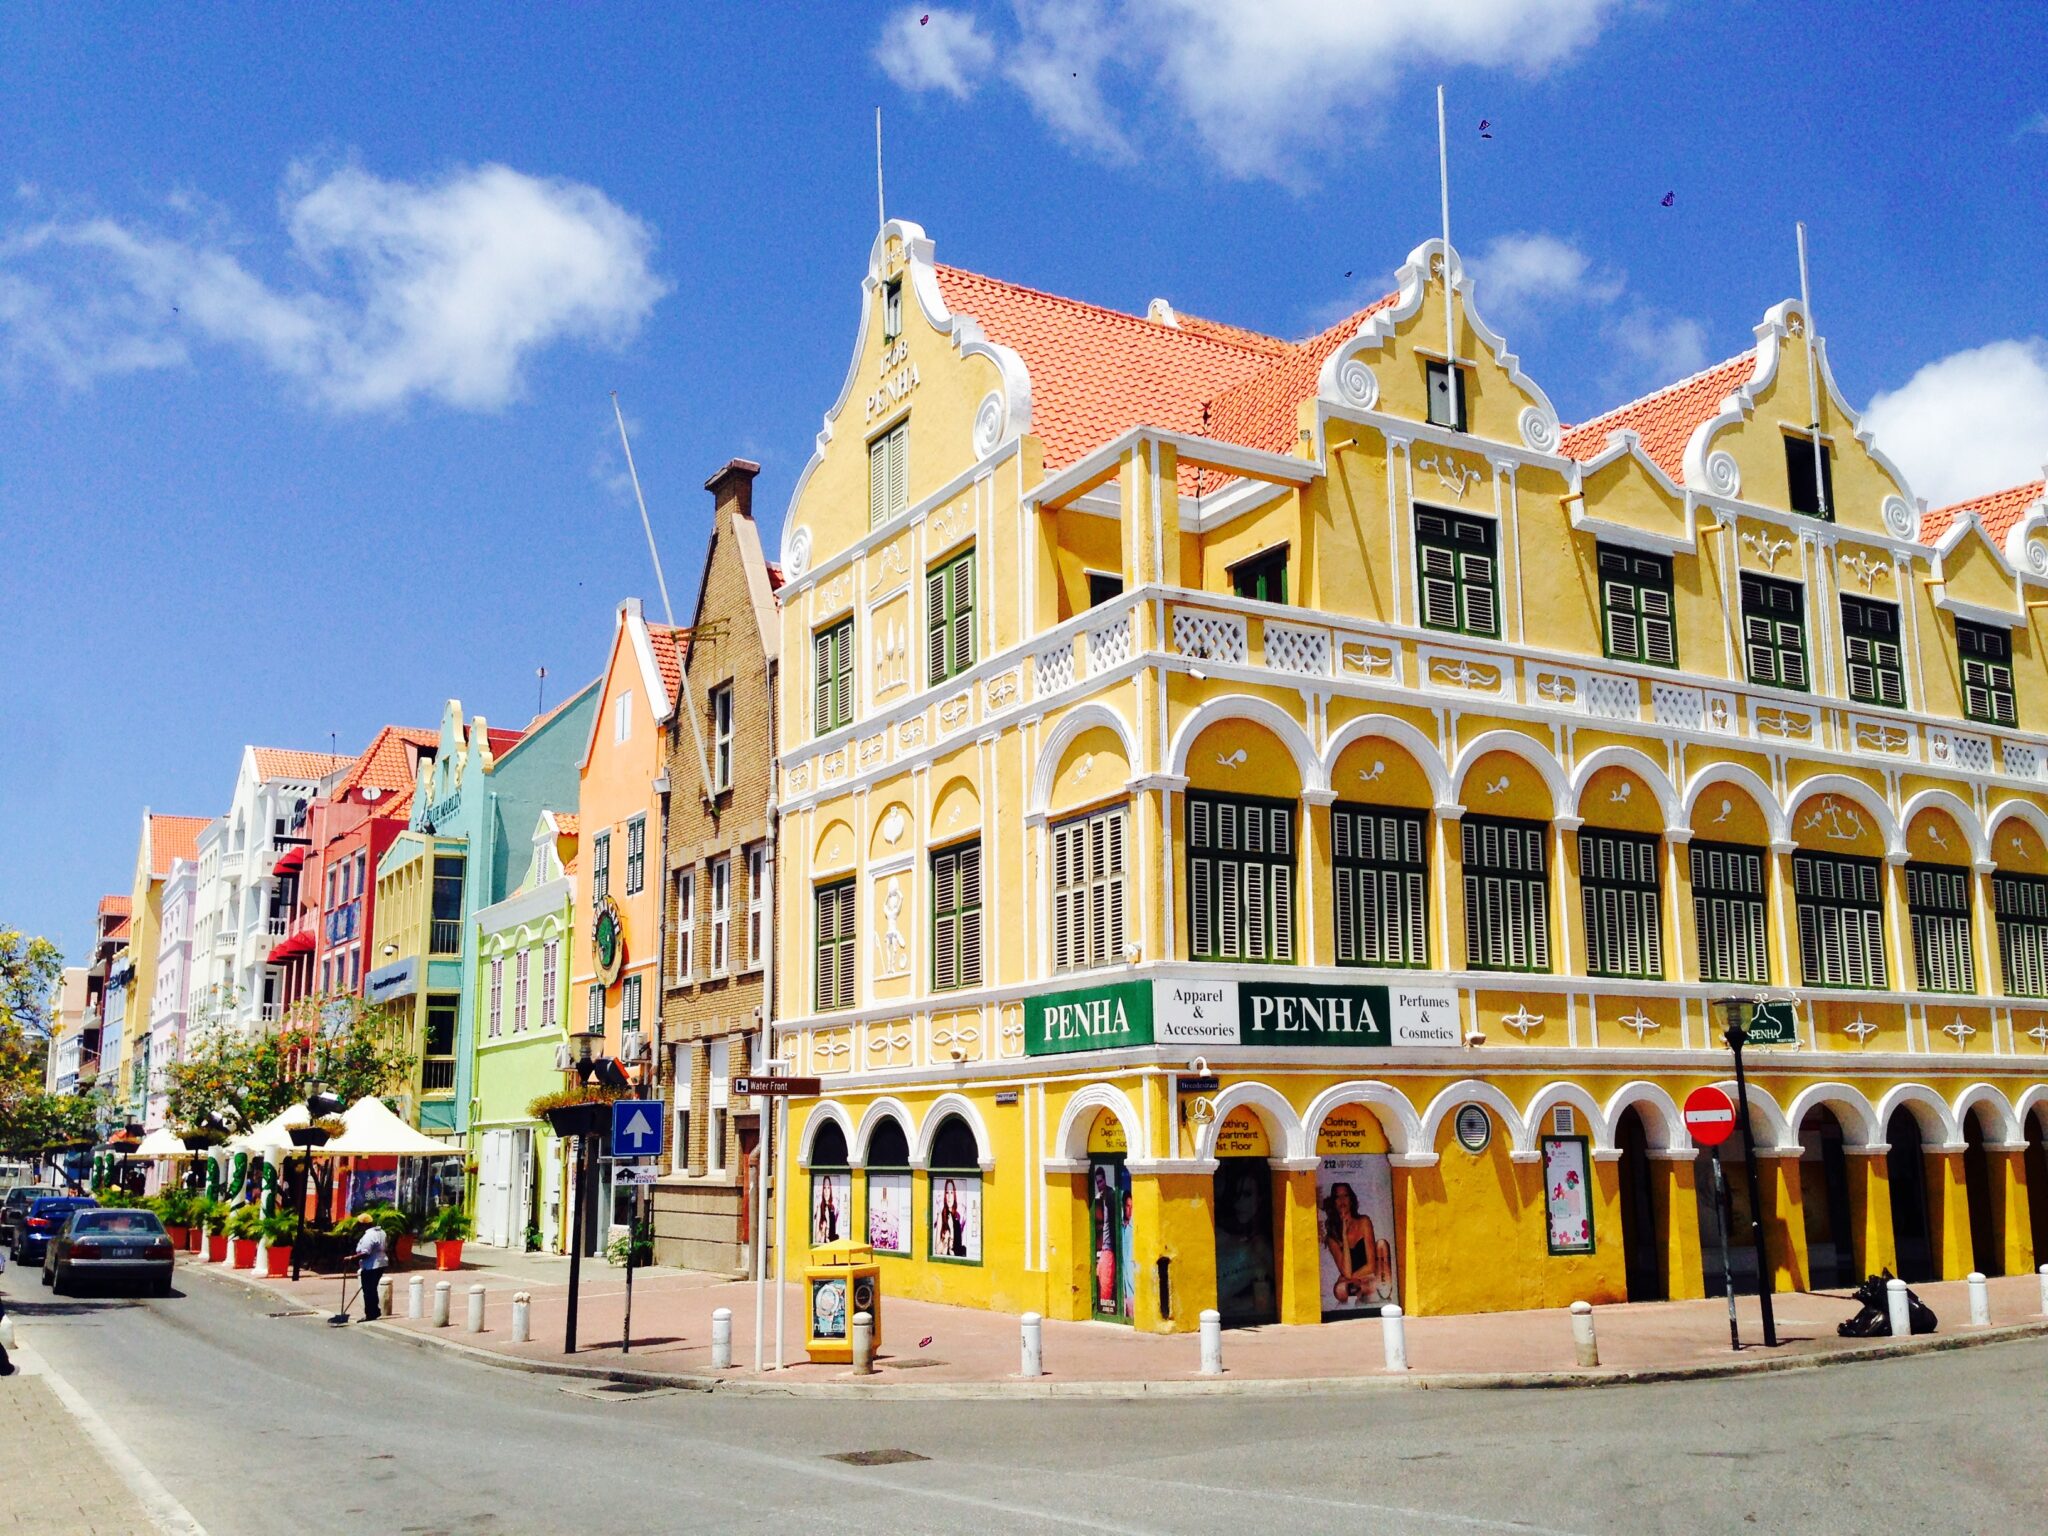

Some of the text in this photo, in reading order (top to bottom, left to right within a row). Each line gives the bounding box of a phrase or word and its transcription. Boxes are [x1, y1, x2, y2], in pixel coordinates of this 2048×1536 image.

[866, 362, 920, 421] PENHA
[1172, 988, 1223, 1005] Apparel
[1399, 994, 1450, 1008] Perfumes
[1192, 1006, 1204, 1019] &
[1250, 996, 1380, 1033] PENHA
[1420, 1010, 1430, 1023] &
[1043, 997, 1130, 1041] PENHA
[1163, 1022, 1235, 1037] Accessories
[1399, 1026, 1454, 1040] Cosmetics
[1750, 1029, 1779, 1040] PENHA
[750, 1081, 788, 1091] Water Front
[1222, 1119, 1248, 1130] othing
[1325, 1117, 1357, 1128] Clothing
[1219, 1132, 1258, 1141] partment
[1319, 1128, 1366, 1139] Department
[1231, 1141, 1252, 1150] Floor
[1341, 1139, 1360, 1148] Floor
[1324, 1160, 1336, 1169] 212
